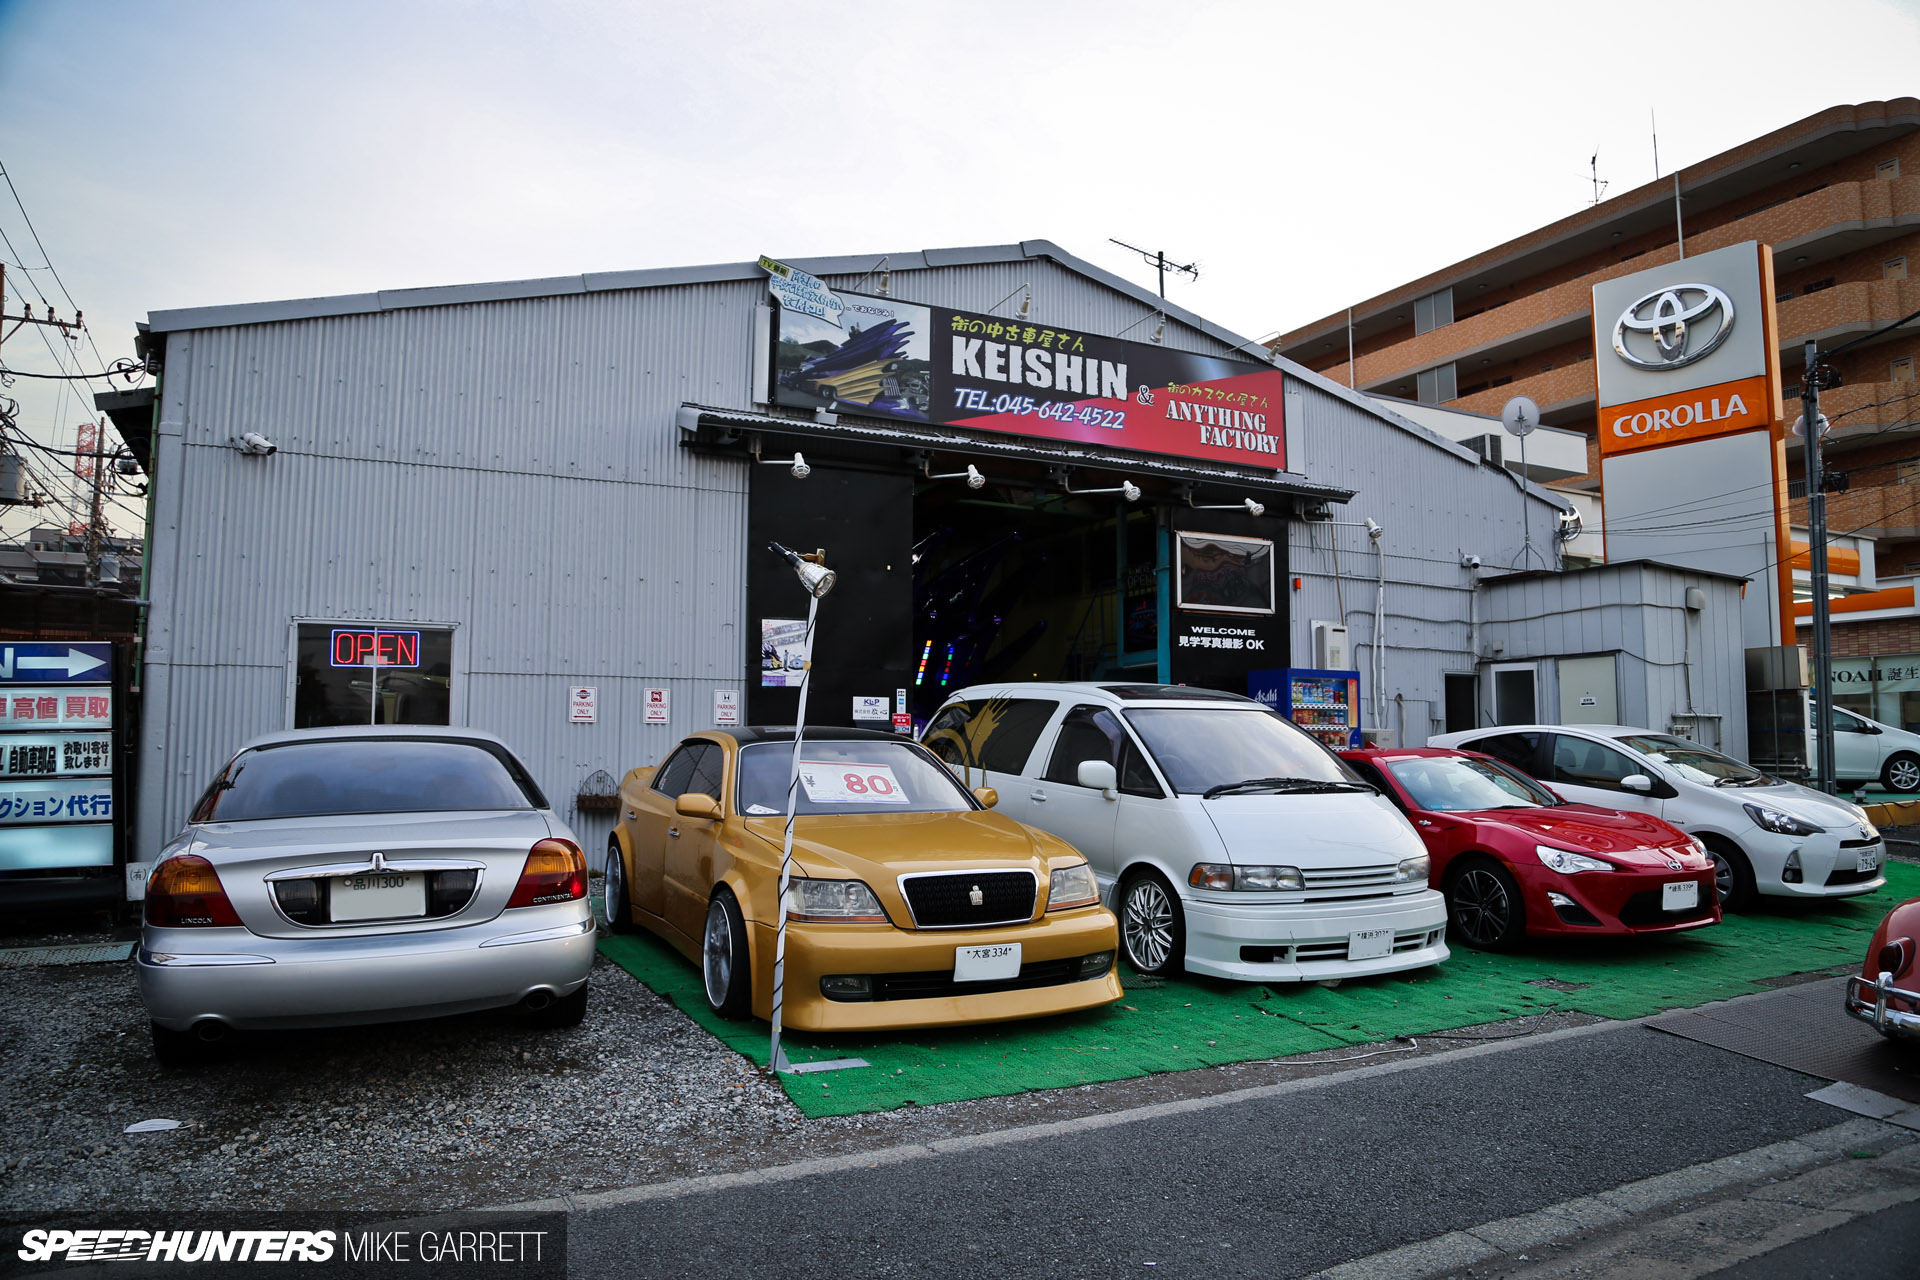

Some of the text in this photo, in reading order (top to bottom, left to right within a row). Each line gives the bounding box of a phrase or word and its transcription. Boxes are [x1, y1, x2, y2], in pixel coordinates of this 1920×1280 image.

[951, 315, 1085, 352] 街の中古車屋さん
[952, 335, 1128, 401] KEISHIN
[1137, 384, 1155, 406] &
[1167, 381, 1269, 409] 街のカスタム屋さん
[1165, 399, 1267, 433] ANYTHING
[1613, 394, 1748, 438] COROLLA
[1200, 424, 1280, 455] FACTORY
[1179, 635, 1265, 650] 見学写真撮影 OK
[1191, 626, 1256, 636] WELCOME
[335, 633, 416, 665] OPEN
[1888, 666, 1919, 681] 誕生
[1254, 688, 1278, 703] Asahi
[13, 696, 58, 719] 高値
[65, 696, 109, 718] 買取
[64, 741, 109, 755] お取り寄せ
[9, 746, 57, 774] 自動車部品
[843, 773, 893, 795] 80
[533, 892, 574, 903] CONTINENTAL
